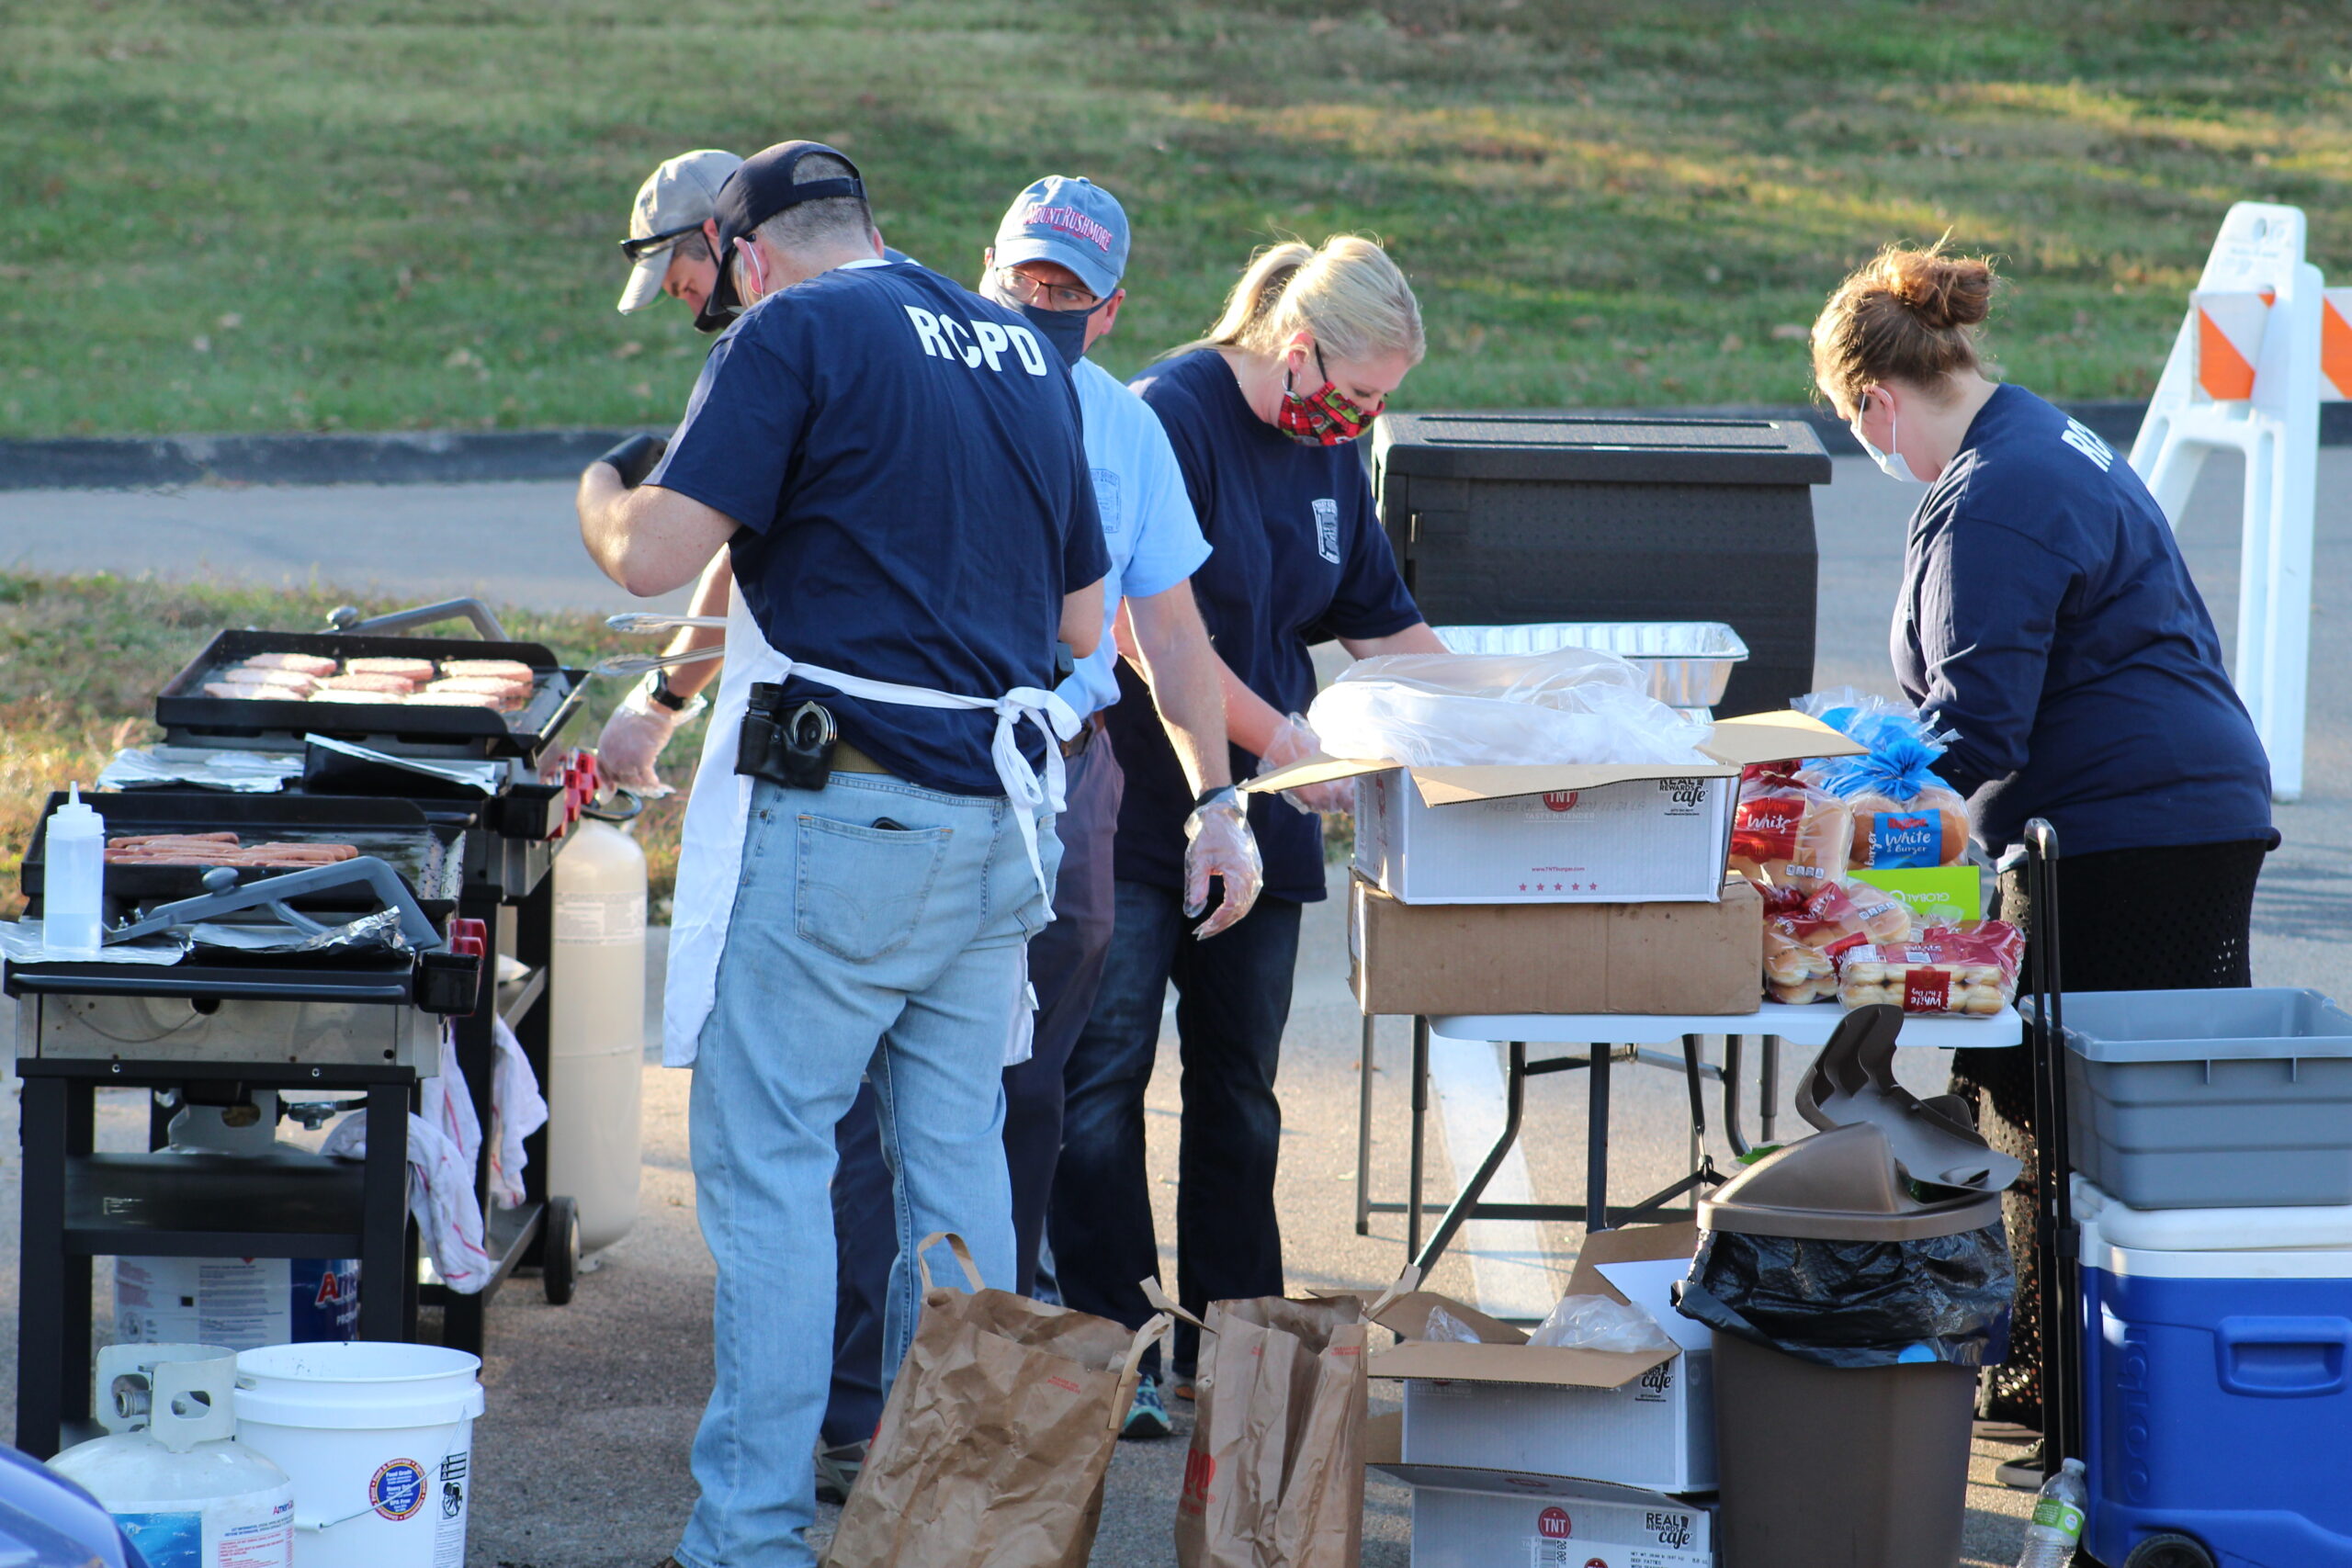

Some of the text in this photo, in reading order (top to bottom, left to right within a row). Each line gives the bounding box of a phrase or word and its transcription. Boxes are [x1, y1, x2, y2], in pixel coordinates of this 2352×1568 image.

[1023, 205, 1066, 225] MOUNT
[1061, 205, 1114, 254] RUSHMORE
[904, 304, 1047, 377] RCPD
[1549, 791, 1573, 804] TNT
[1884, 829, 1931, 847] White
[1910, 996, 1942, 1009] White
[1544, 1517, 1566, 1534] TNT
[1646, 1513, 1679, 1526] REAL
[1646, 1524, 1679, 1532] REWARDS
